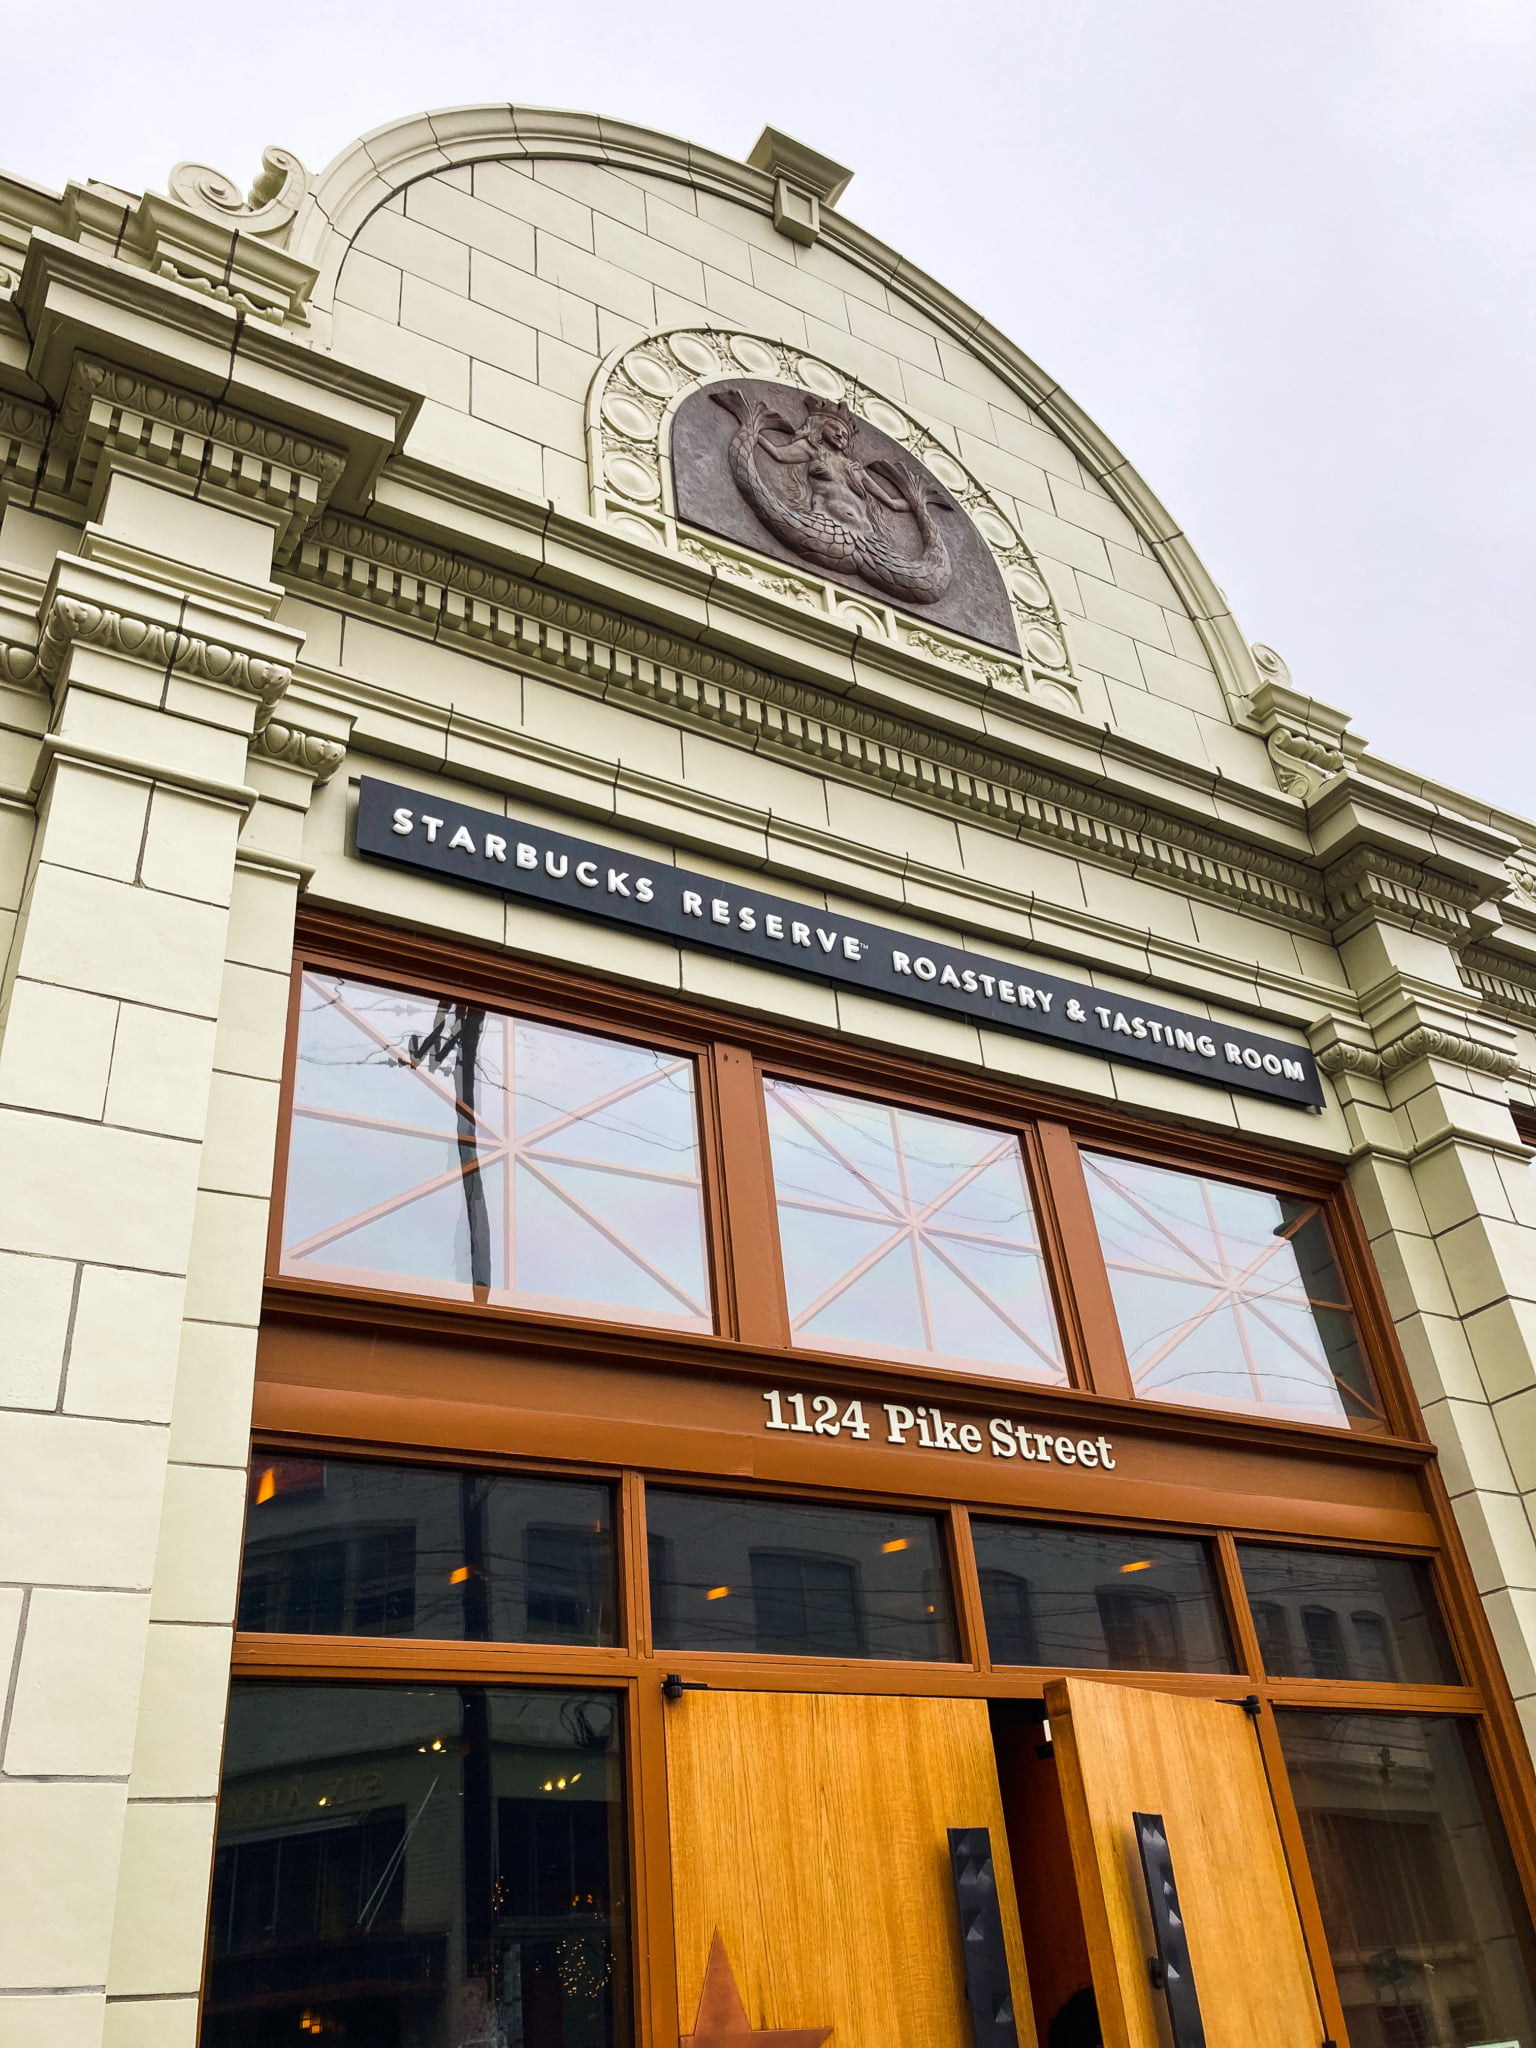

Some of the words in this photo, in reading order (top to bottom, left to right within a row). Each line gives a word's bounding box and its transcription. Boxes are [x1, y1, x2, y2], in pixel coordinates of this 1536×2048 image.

[392, 807, 655, 903] STARBUCKS
[892, 950, 1054, 1013] ROASTERY
[1066, 998, 1087, 1023] &
[1094, 1006, 1217, 1058] TASTING
[1223, 1041, 1306, 1082] ROOM
[763, 1389, 870, 1440] 1124
[883, 1403, 983, 1453] Pike
[989, 1418, 1116, 1470] Street
